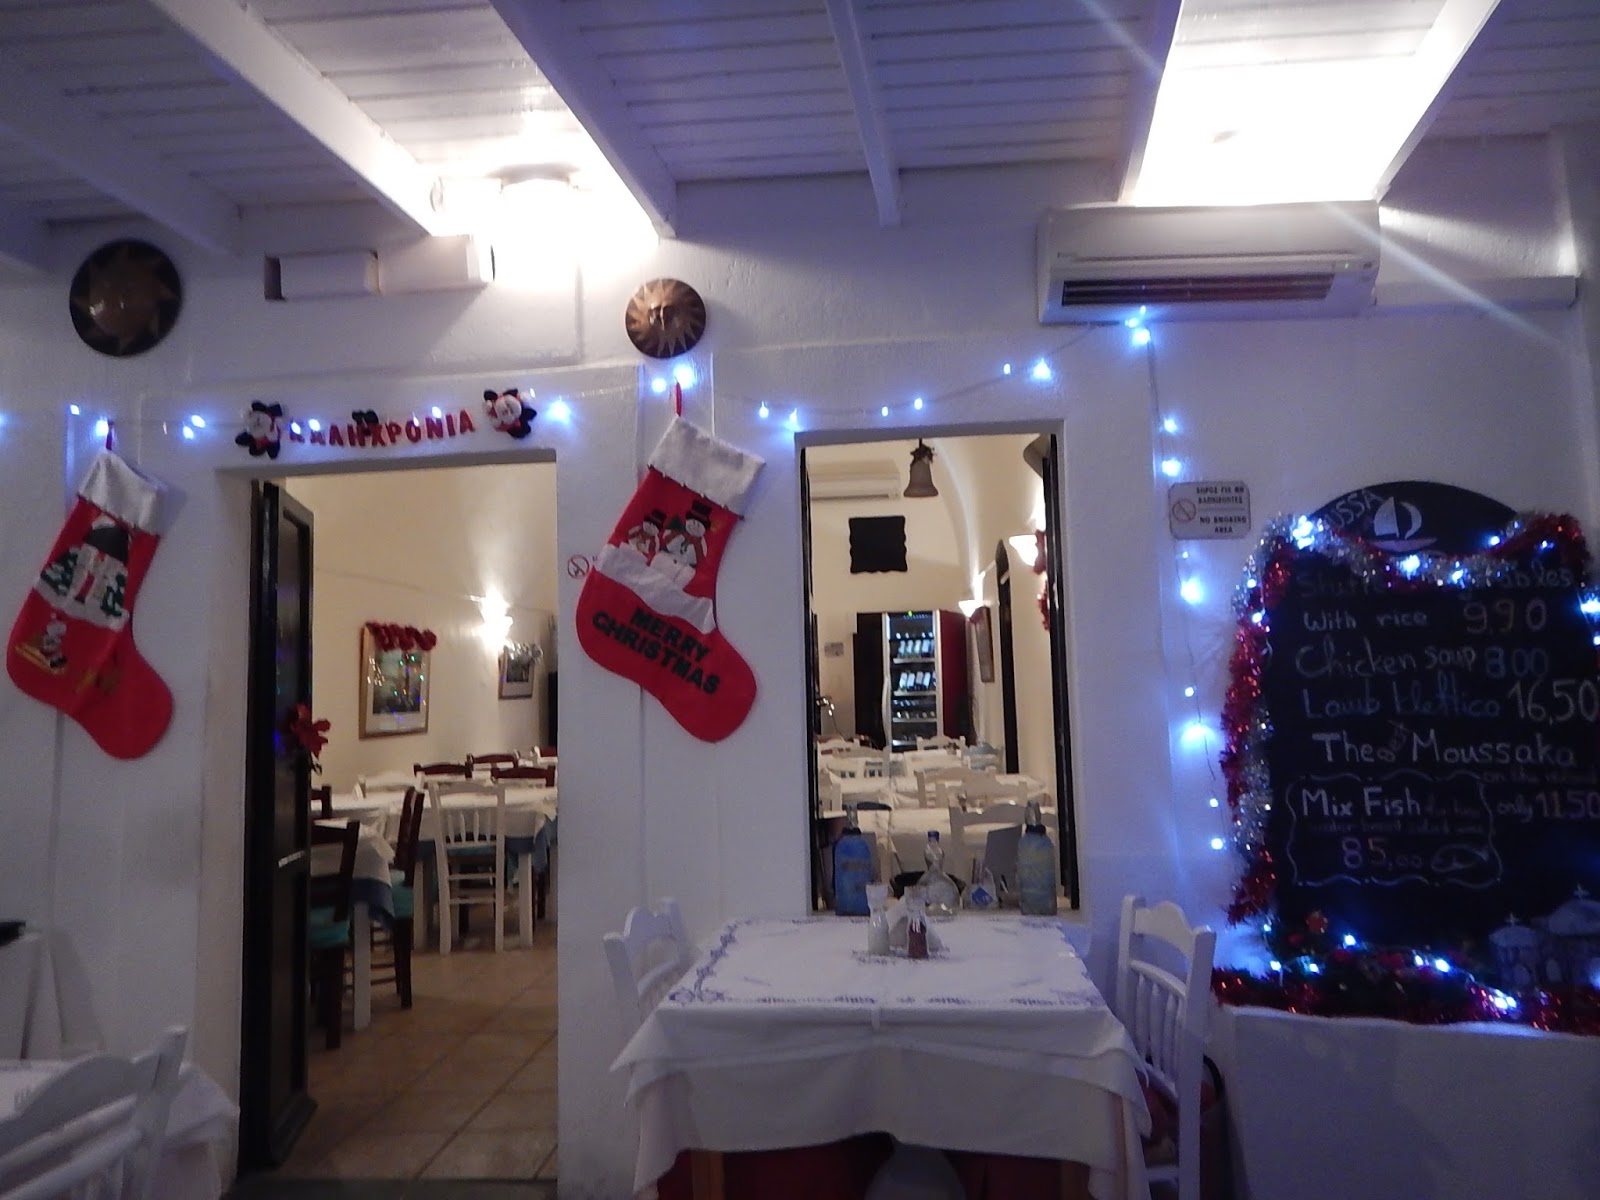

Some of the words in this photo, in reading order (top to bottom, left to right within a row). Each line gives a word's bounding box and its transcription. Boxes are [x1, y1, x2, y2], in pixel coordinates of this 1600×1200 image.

[1199, 516, 1211, 524] NO
[1213, 516, 1247, 524] SMOKING
[629, 607, 710, 663] MERRY
[1376, 610, 1428, 628] rice
[592, 612, 721, 694] CHRISTMAS
[1295, 633, 1417, 679] Chicken
[1424, 645, 1476, 672] soup
[1311, 729, 1376, 763] The
[1412, 729, 1578, 767] Moussaka
[1301, 787, 1354, 816] Mix
[1362, 785, 1421, 816] Fish
